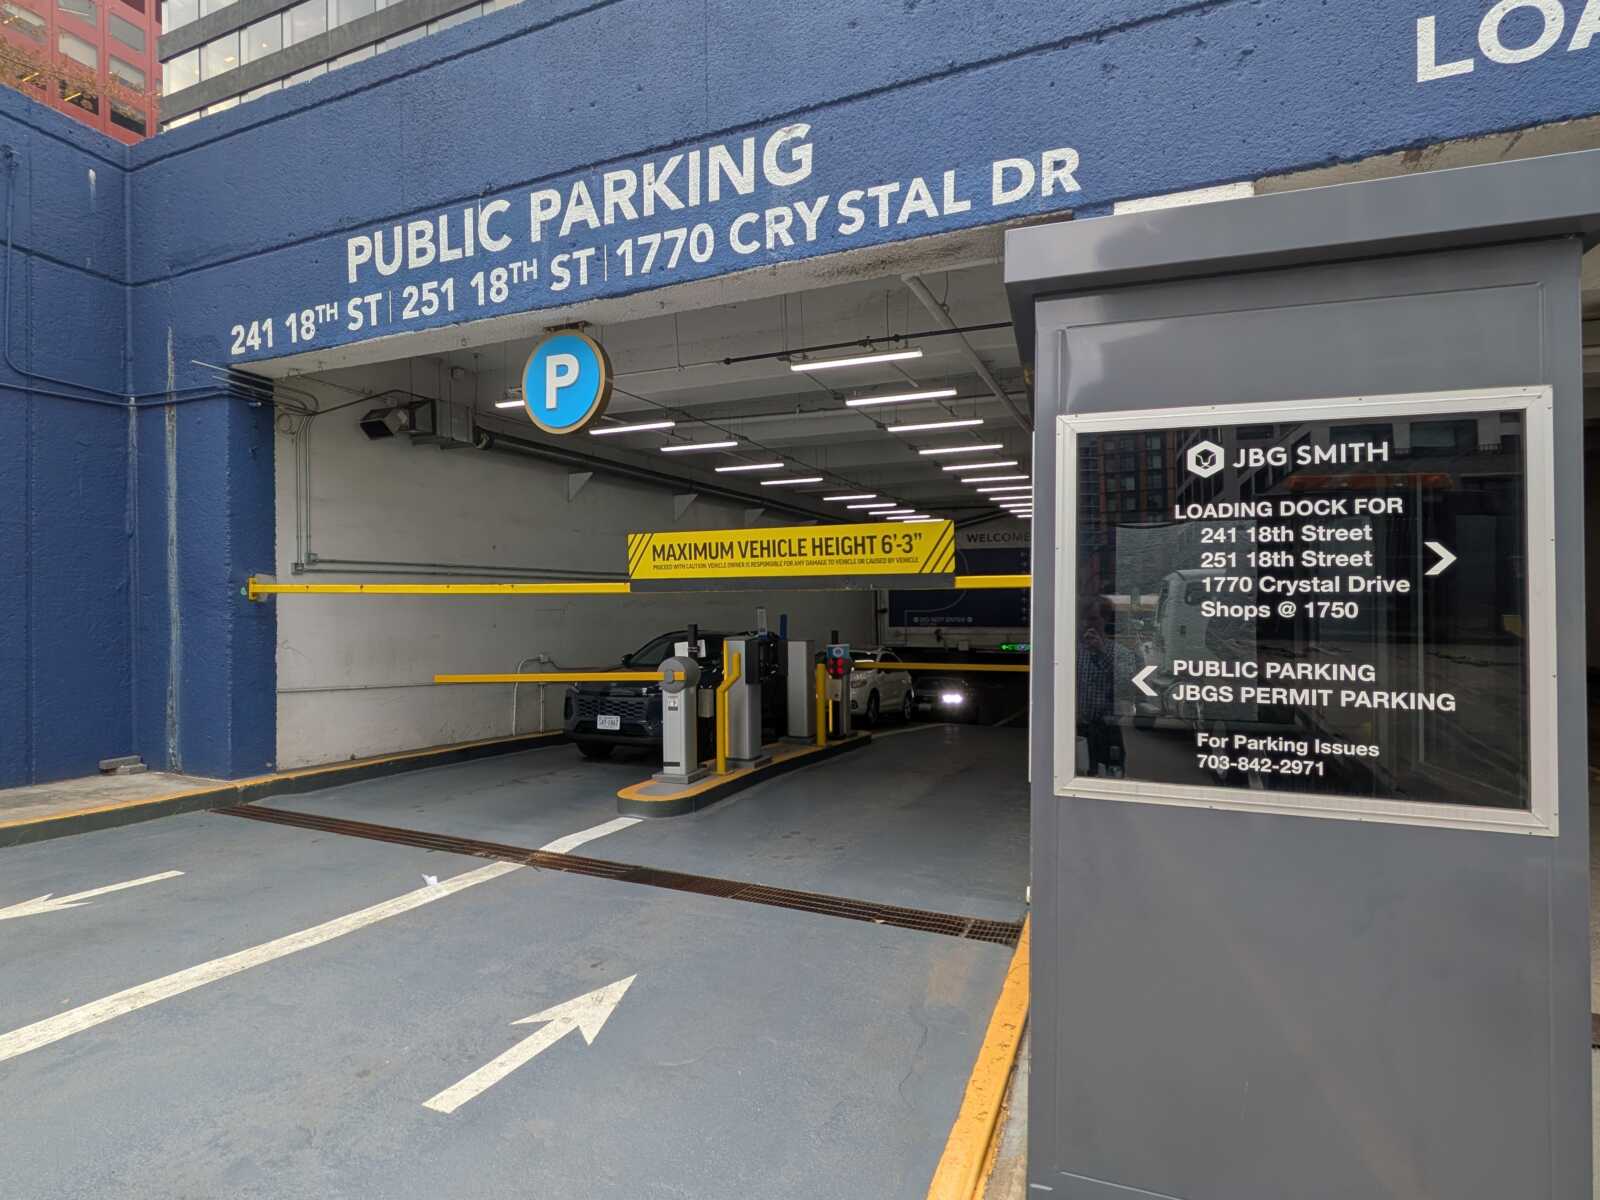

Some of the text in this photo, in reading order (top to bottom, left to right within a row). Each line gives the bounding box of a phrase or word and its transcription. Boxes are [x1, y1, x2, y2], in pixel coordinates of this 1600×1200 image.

[347, 122, 814, 284] PUBLIC PARKING
[231, 147, 1081, 355] 241 18TH ST 251 18TH ST 1770 CRYSTAL DR
[545, 353, 580, 407] P
[1232, 441, 1389, 468] JBG SMITH
[1174, 497, 1403, 520] LOADING DOCK FOR
[1200, 524, 1373, 544] 241 18th Street
[652, 540, 734, 562] MAXIMUM
[737, 537, 808, 559] VEHICLE
[811, 534, 877, 557] HEIGHT
[1200, 549, 1373, 569] 251 18th Street
[1201, 575, 1411, 597] 1770 Crystal Drive
[1200, 600, 1359, 622] Shops @ 1750
[1172, 659, 1376, 682] PUBLIC PARKING
[1171, 684, 1456, 712] JBGS PERMIT PARKING
[1197, 732, 1380, 757] For Parking Issues
[1196, 753, 1324, 776] 703-842-2971
